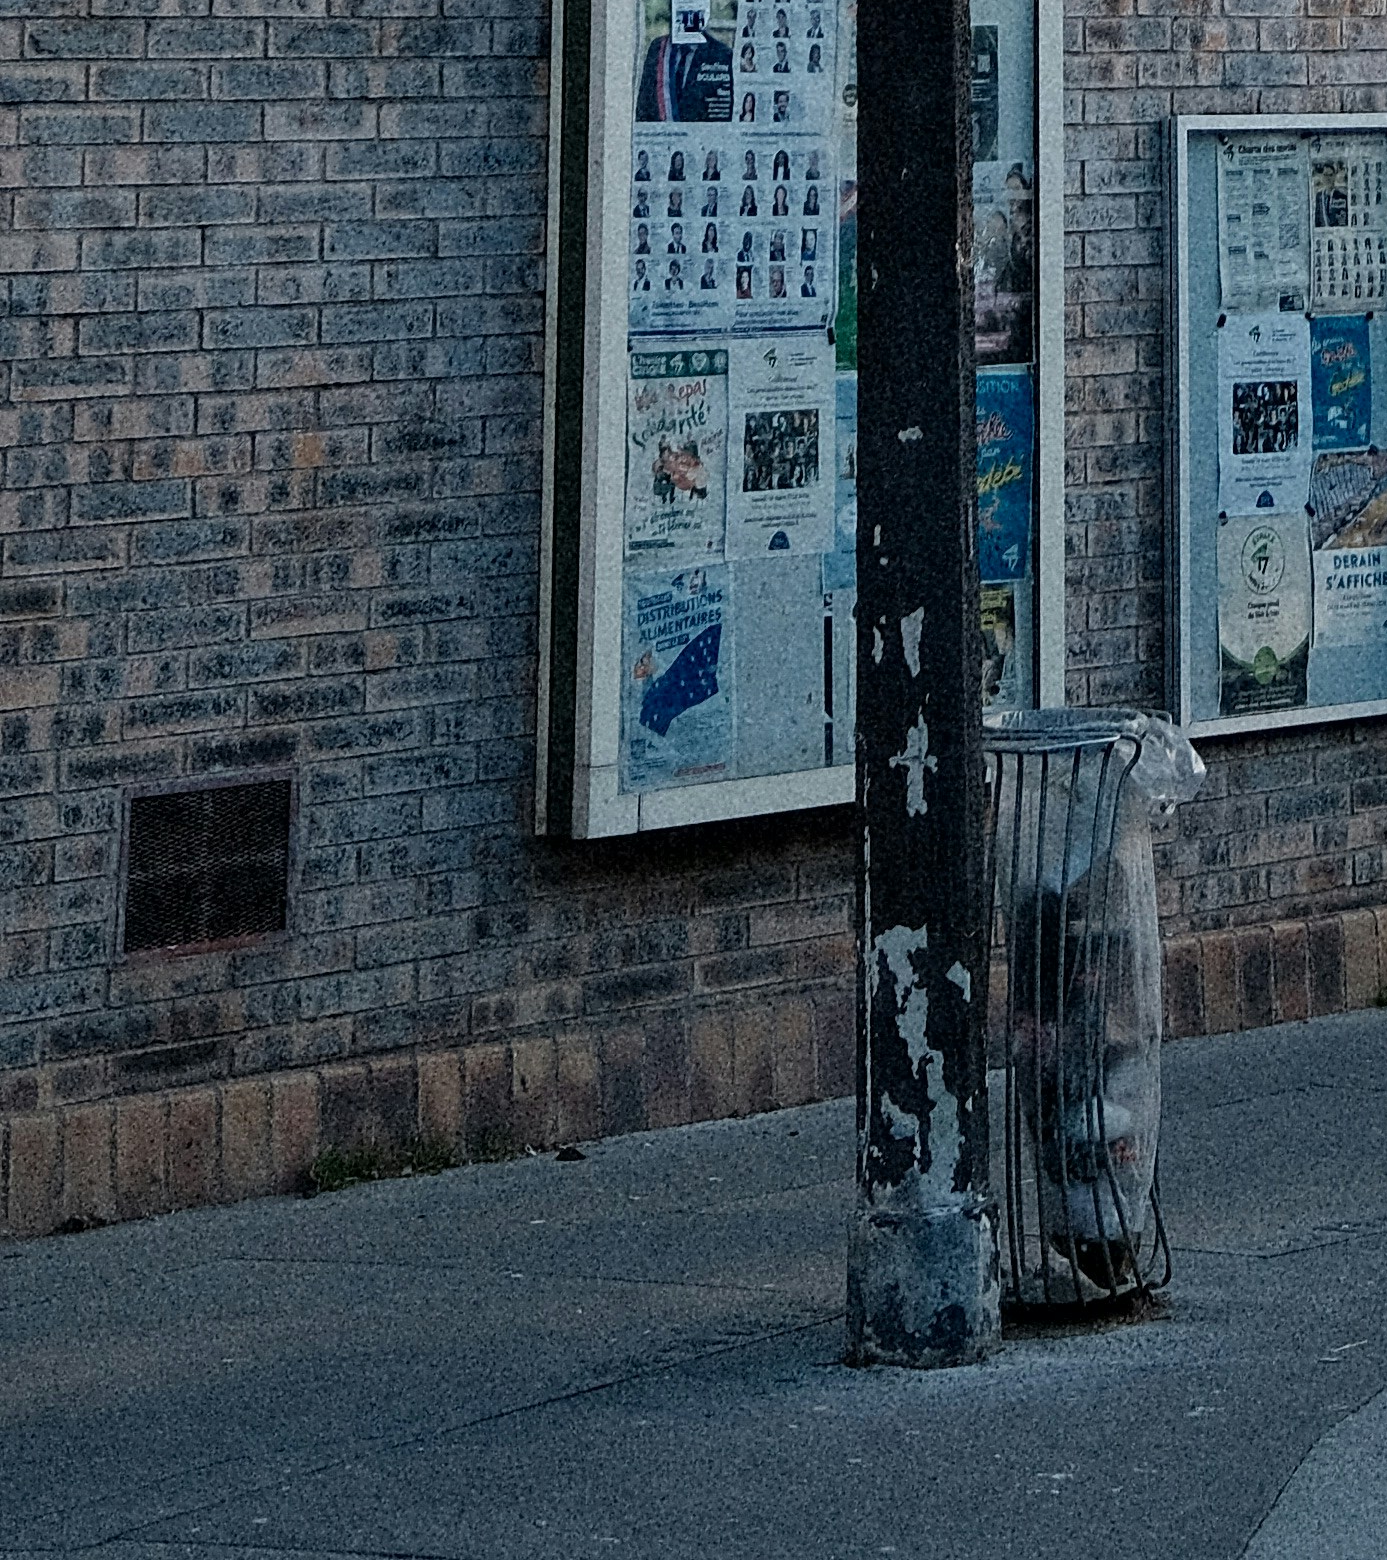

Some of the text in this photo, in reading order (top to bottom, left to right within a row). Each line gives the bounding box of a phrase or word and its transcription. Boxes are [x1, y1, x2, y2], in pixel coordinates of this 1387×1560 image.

[1258, 556, 1270, 575] 17
[1332, 551, 1382, 570] DERAIN
[637, 589, 723, 627] DISTRIBUTIONS
[638, 607, 722, 644] ALIMENTAIRES
